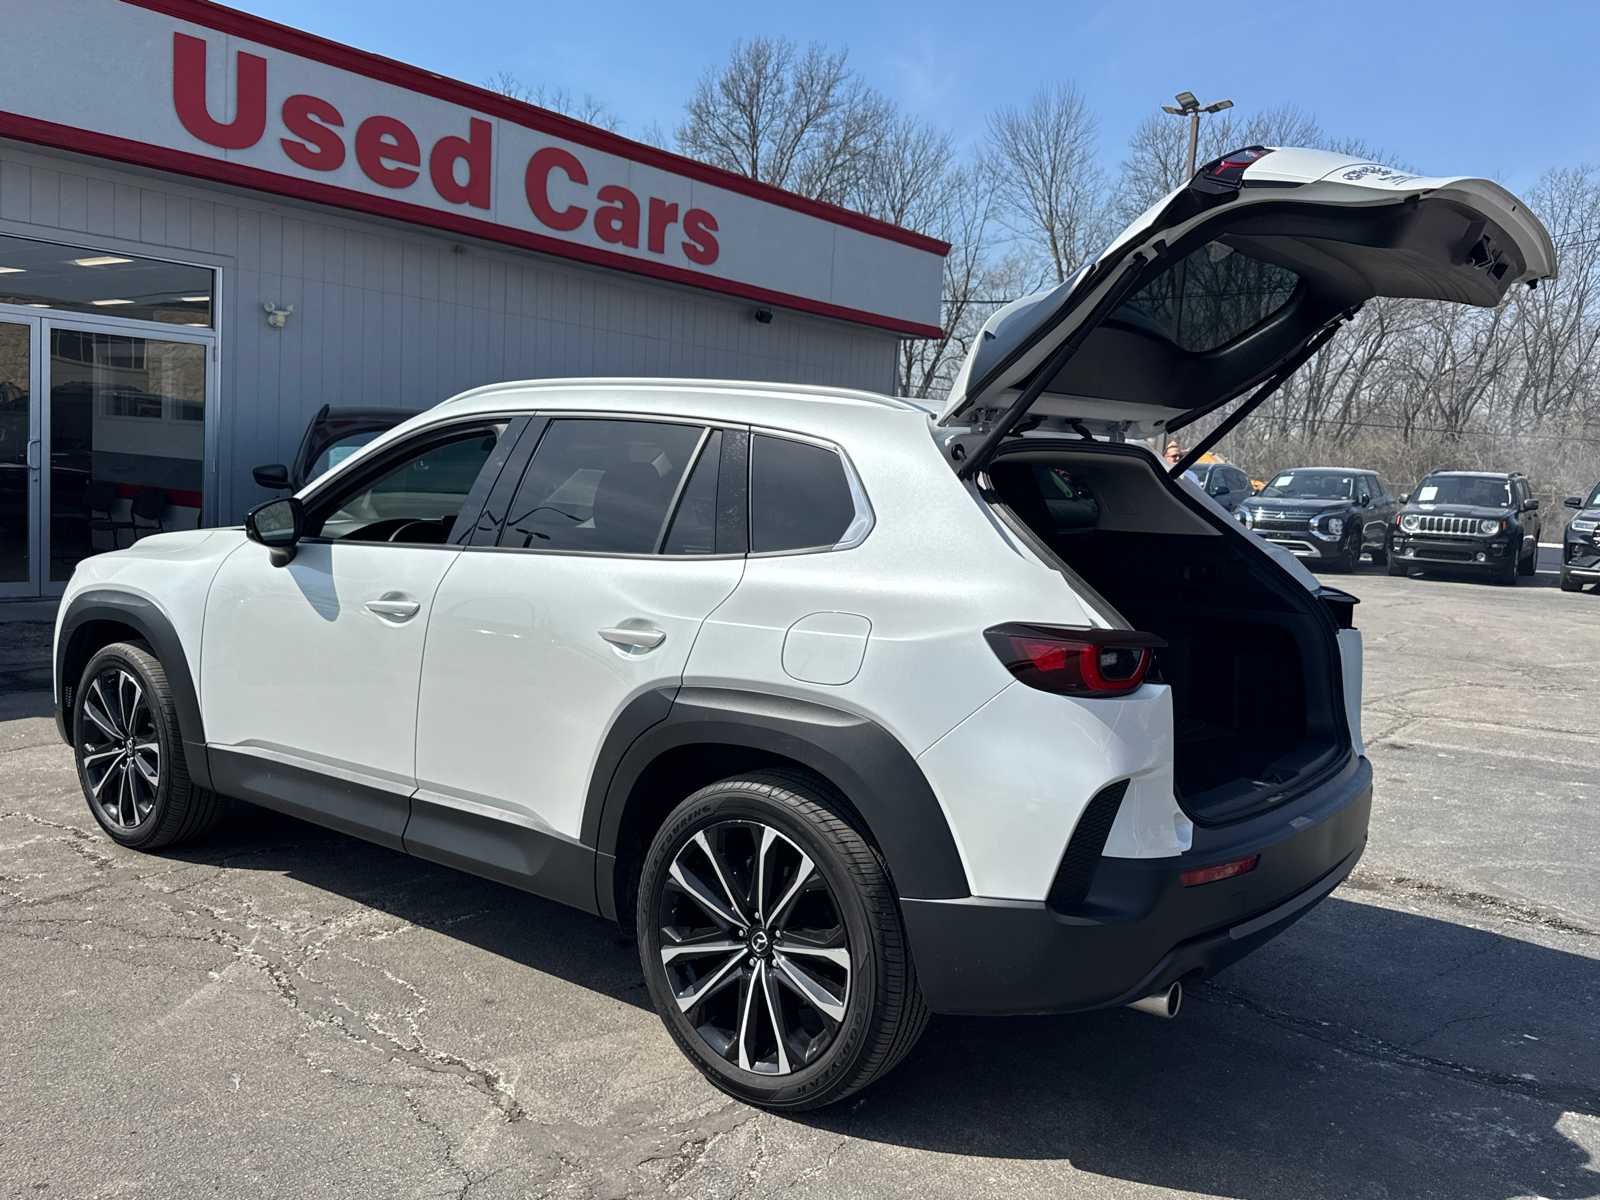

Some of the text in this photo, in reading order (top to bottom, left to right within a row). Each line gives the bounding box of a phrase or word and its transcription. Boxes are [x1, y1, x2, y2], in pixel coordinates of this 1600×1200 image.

[173, 32, 719, 265] Used Cars
[659, 804, 711, 853] TOURING
[796, 994, 867, 1094] GOODYEAR
